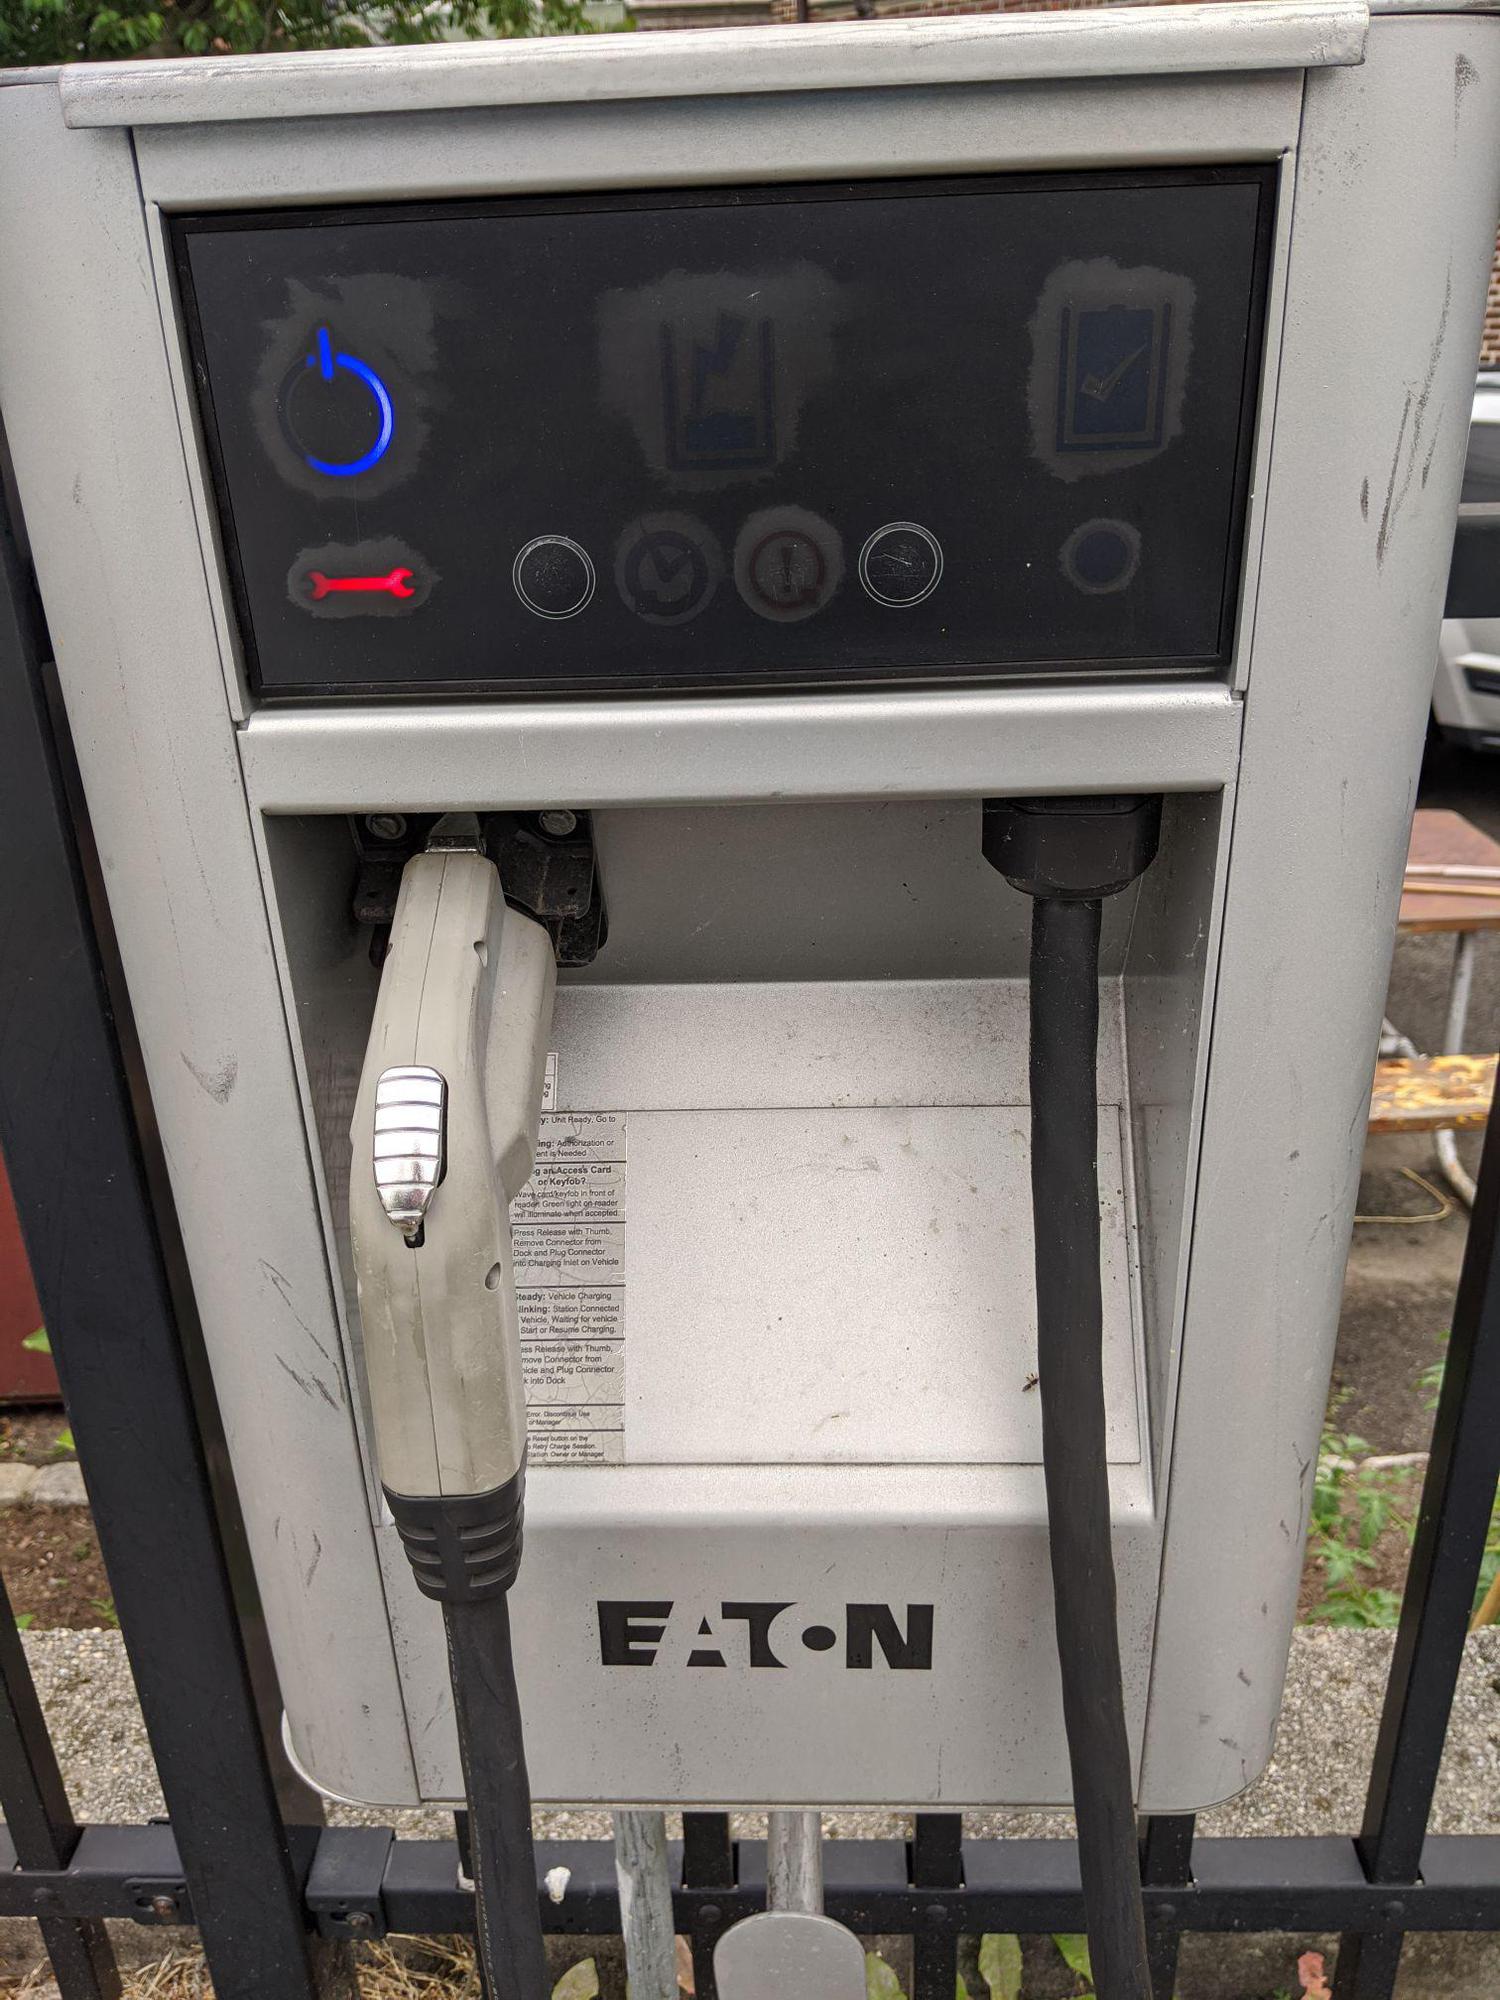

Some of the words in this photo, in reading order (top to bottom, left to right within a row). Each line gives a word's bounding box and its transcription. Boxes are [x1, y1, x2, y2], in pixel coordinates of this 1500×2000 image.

[590, 1166, 611, 1174] Card
[550, 1177, 586, 1187] Keyfob?
[607, 1189, 615, 1197] of
[542, 1200, 564, 1208] Green
[566, 1200, 581, 1209] light
[537, 1228, 566, 1236] Release
[514, 1239, 544, 1247] Remove
[513, 1249, 532, 1257] Dock
[550, 1249, 566, 1257] Plug
[567, 1248, 606, 1256] Connector
[528, 1260, 561, 1268] Charging
[592, 1258, 619, 1266] Vehicle
[549, 1292, 576, 1300] Vehicle
[577, 1292, 611, 1301] Charging
[519, 1305, 550, 1314] linking:
[553, 1305, 578, 1313] Station
[580, 1304, 619, 1312] Connected
[551, 1316, 578, 1324] Waiting
[520, 1326, 538, 1334] Start
[535, 1345, 565, 1353] Release
[585, 1344, 613, 1352] Thumb,
[585, 1355, 602, 1363] from
[557, 1366, 573, 1375] Plug
[546, 1376, 566, 1384] Dock
[597, 1601, 934, 1670] EATON
